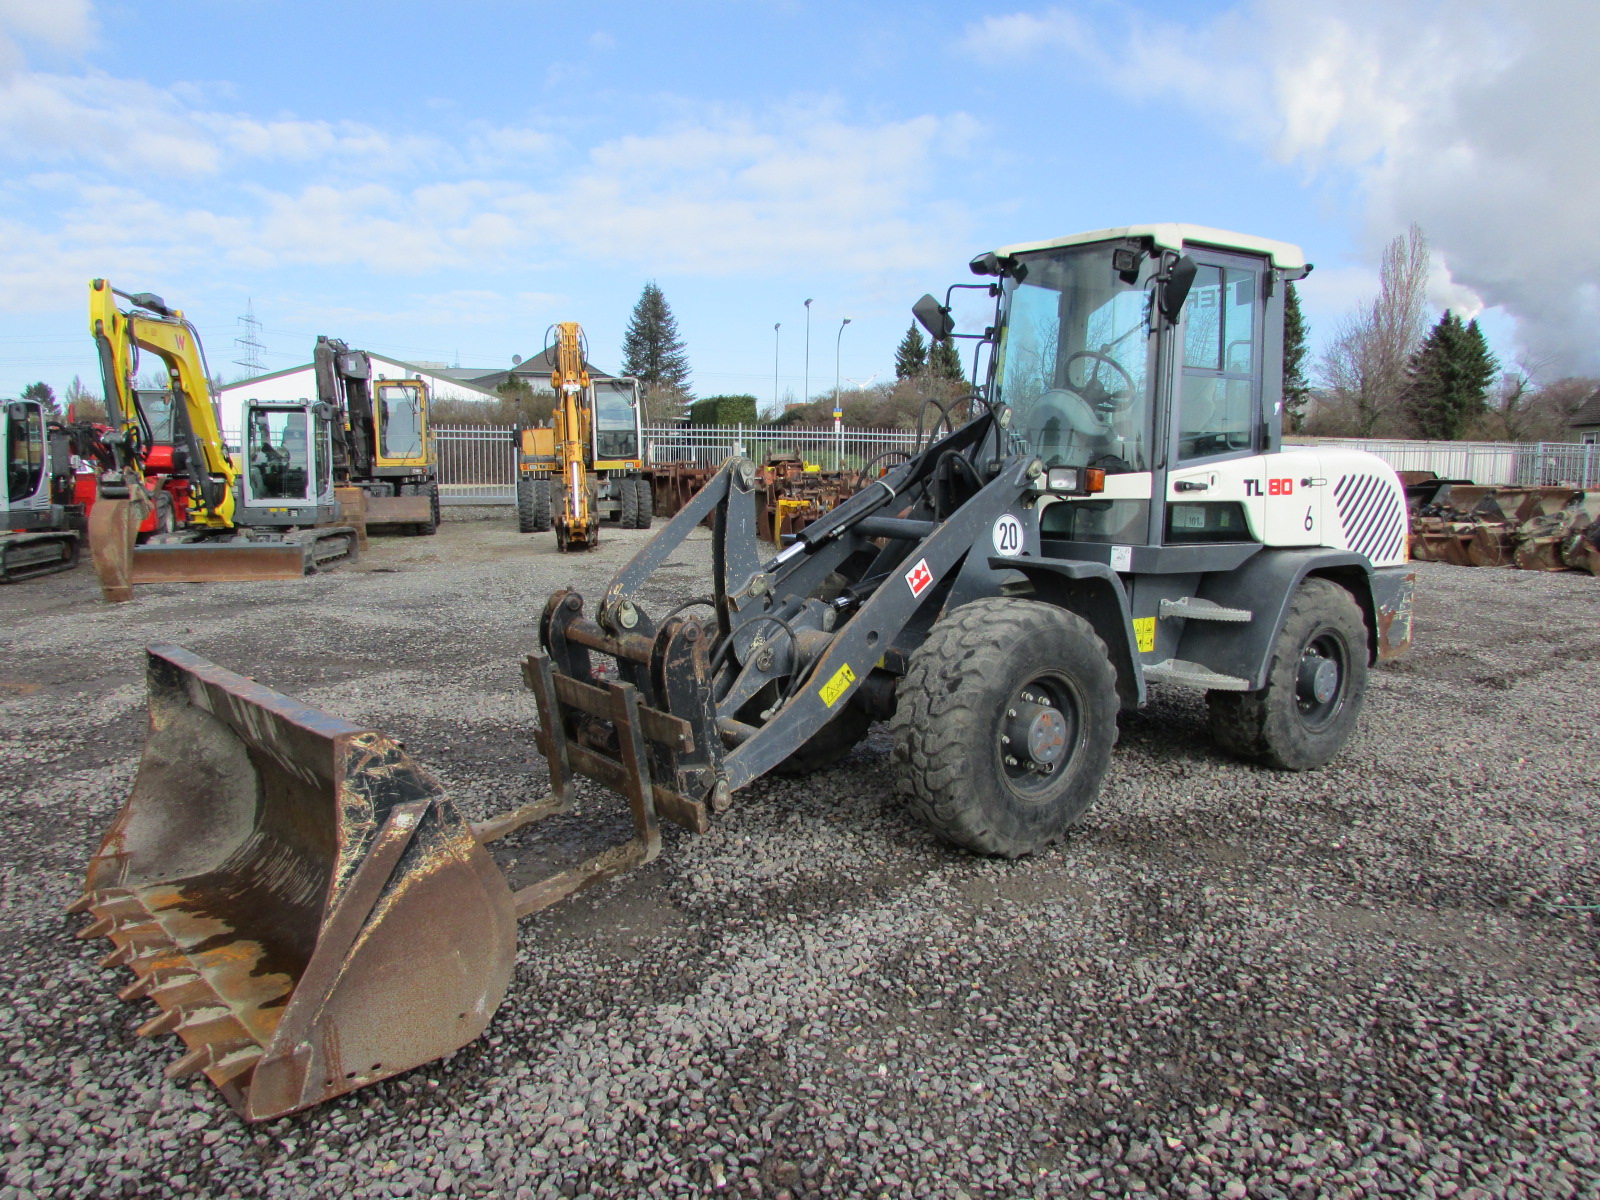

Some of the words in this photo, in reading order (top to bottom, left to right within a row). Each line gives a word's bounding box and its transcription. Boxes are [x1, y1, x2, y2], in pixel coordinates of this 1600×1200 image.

[1243, 479, 1263, 496] TL
[1269, 478, 1292, 495] 80
[1304, 505, 1313, 531] 6
[999, 522, 1017, 550] 20
